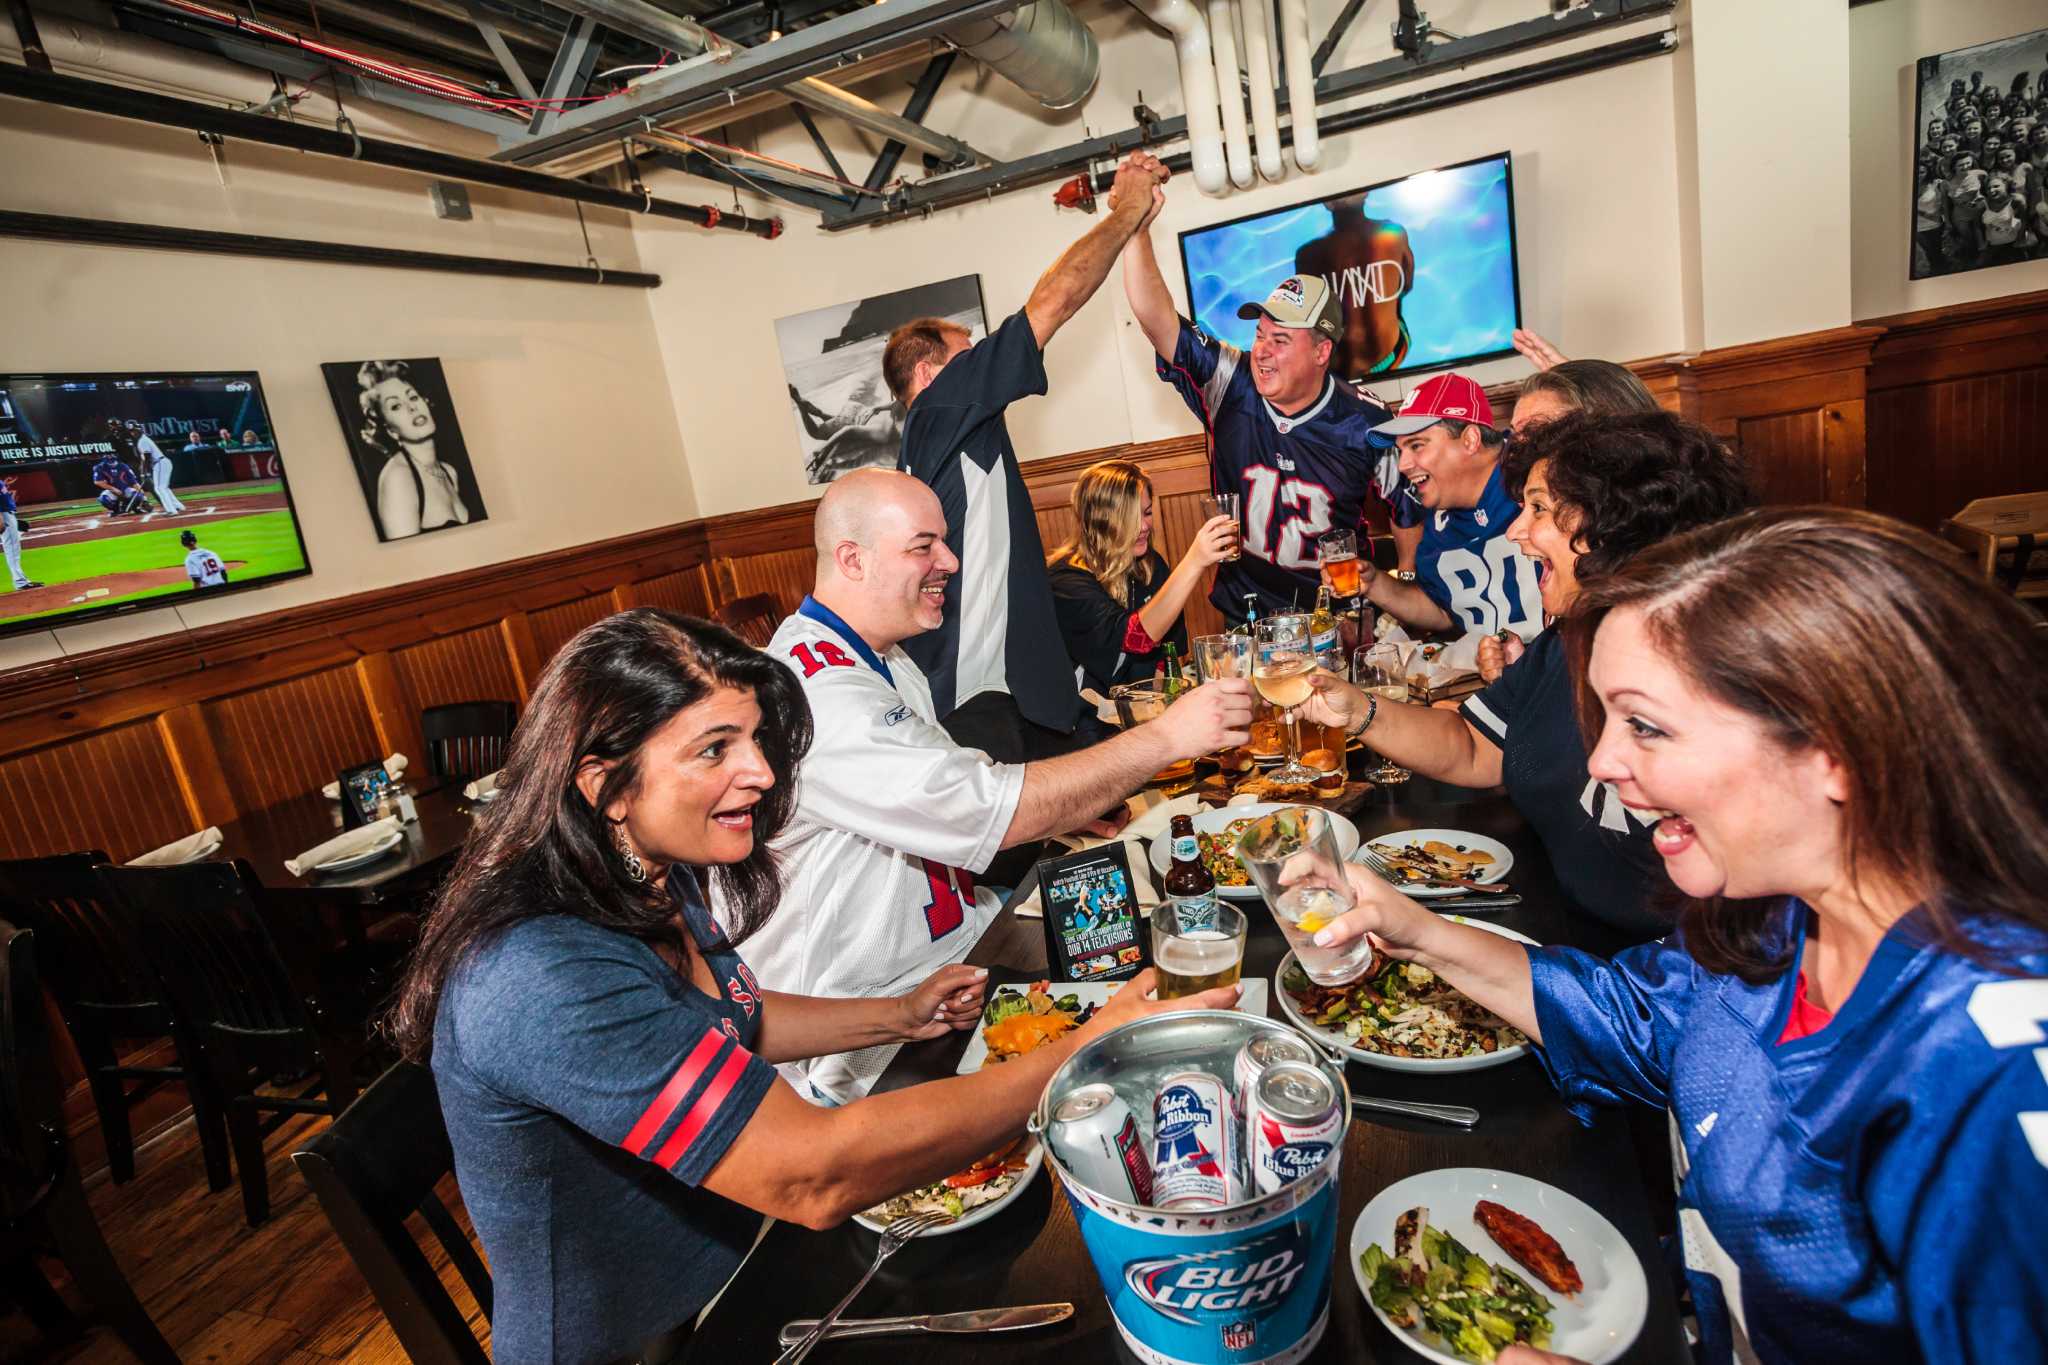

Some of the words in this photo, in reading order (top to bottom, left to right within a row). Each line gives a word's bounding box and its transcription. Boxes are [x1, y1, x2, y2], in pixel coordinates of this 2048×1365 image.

[143, 416, 219, 436] UNTRUST
[1, 447, 31, 459] HERE
[31, 446, 43, 457] IS
[45, 443, 79, 456] JUSTIN
[1241, 463, 1336, 570] 12
[203, 558, 218, 577] 19
[1436, 533, 1545, 644] 80
[1067, 942, 1082, 957] OUR
[1082, 939, 1091, 953] 14
[1091, 927, 1134, 950] TELEVISIONS
[1159, 1093, 1190, 1117] Pabst
[1166, 1108, 1209, 1126] Ribbon
[1265, 1156, 1296, 1178] Blue
[1283, 1147, 1325, 1166] Pabst
[1175, 1249, 1295, 1290] BUD
[1153, 1261, 1306, 1311] LIGHT
[1225, 1331, 1255, 1349] NFL
